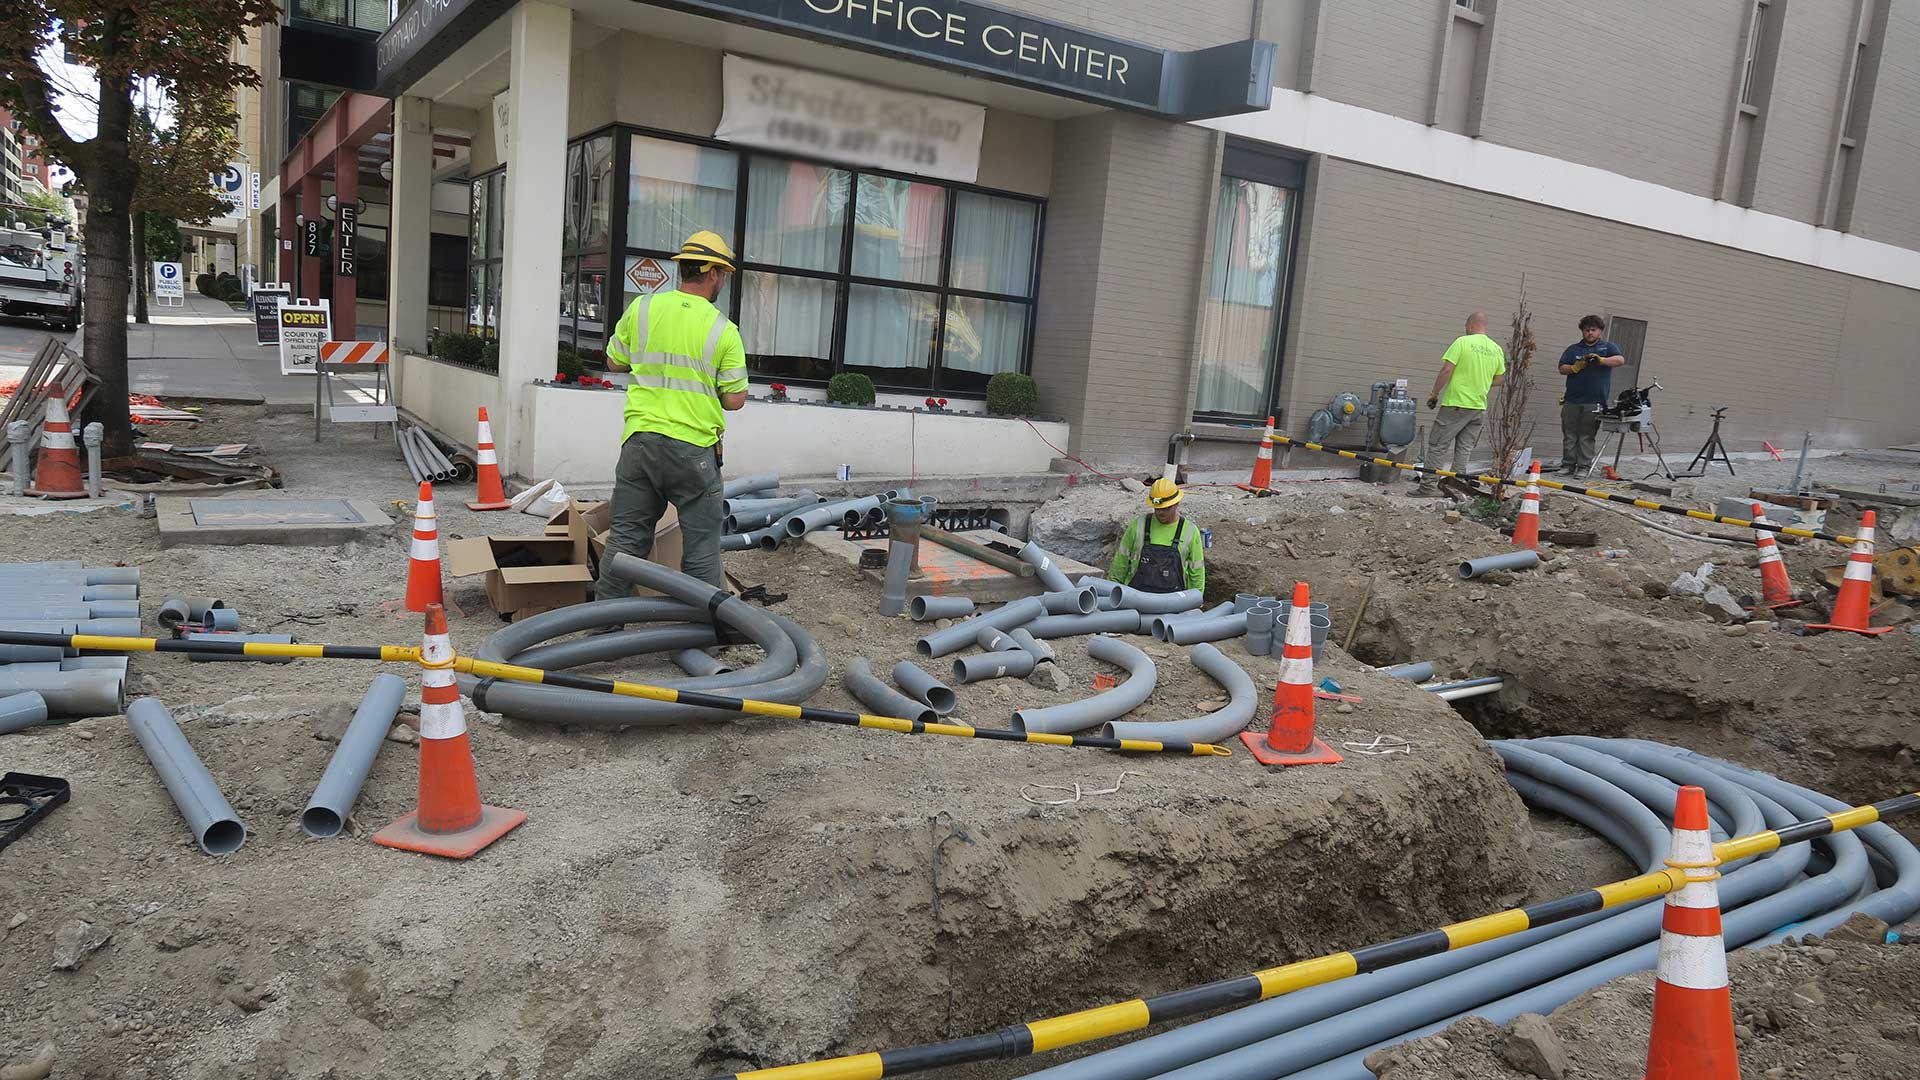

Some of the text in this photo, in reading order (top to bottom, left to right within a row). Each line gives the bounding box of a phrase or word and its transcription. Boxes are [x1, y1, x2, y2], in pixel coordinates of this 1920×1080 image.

[376, 10, 420, 71] COURTYARD
[981, 25, 1130, 84] CENTER
[308, 222, 317, 255] 827
[341, 207, 353, 274] ENTER
[283, 312, 325, 324] OPEN!
